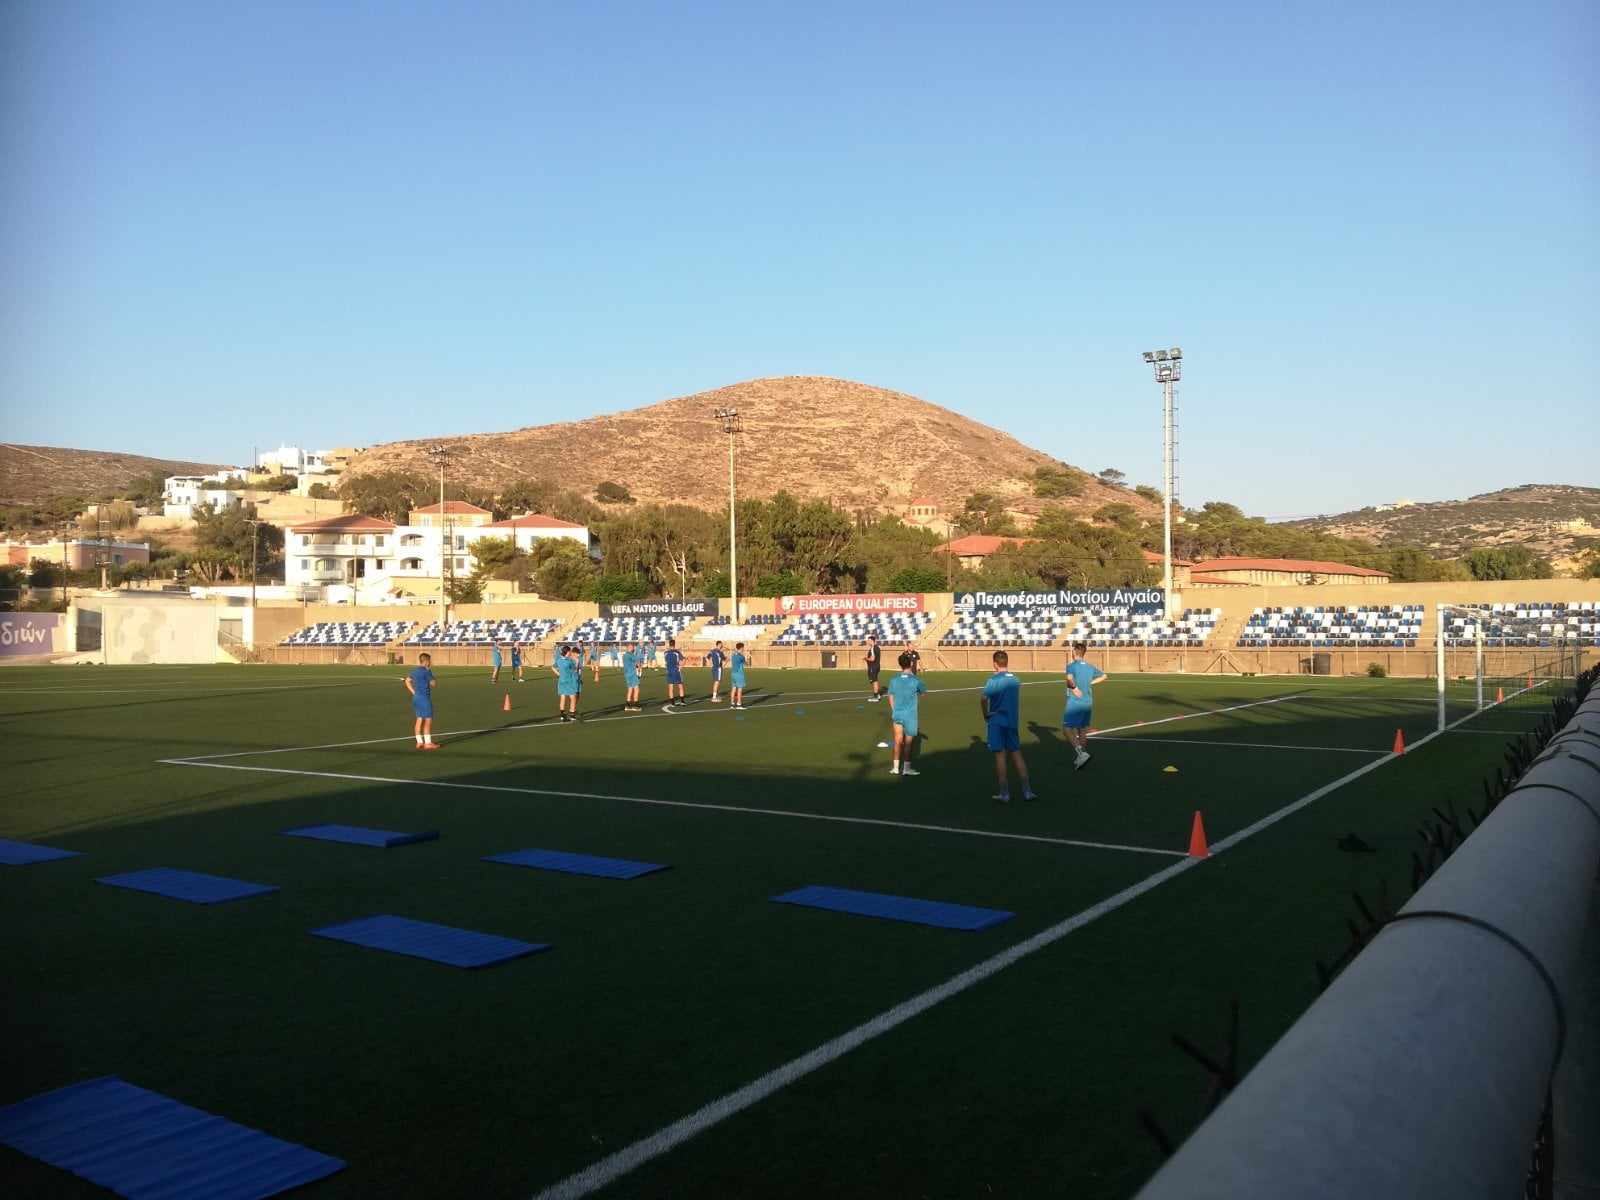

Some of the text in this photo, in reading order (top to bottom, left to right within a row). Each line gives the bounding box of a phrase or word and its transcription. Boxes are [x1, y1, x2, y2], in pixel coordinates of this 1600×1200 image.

[799, 597, 918, 610] EUROPEAN QUALIFIERS
[976, 591, 1057, 608] Περιφέρεια
[1060, 590, 1110, 604] Νοτίου
[611, 602, 705, 614] UEFA NATIONS LEAGUE
